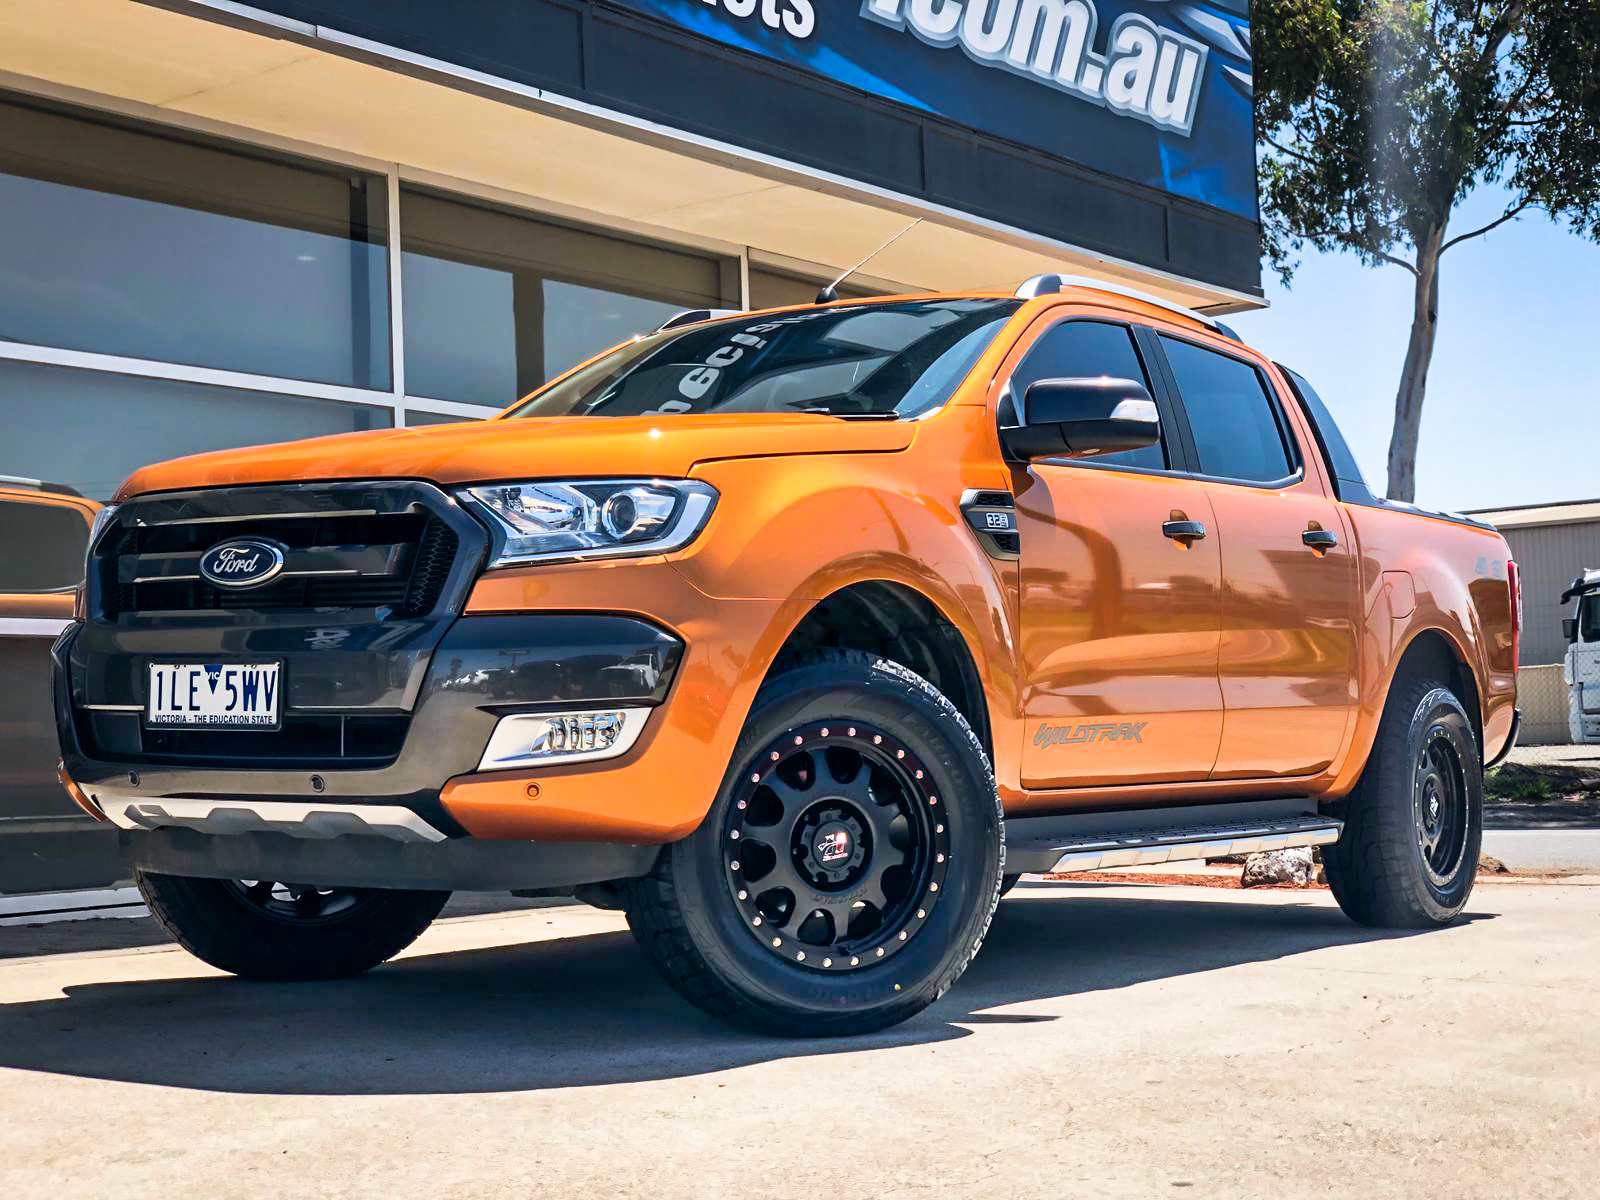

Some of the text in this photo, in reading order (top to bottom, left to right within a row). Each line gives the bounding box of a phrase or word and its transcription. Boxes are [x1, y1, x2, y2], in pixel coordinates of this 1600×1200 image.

[213, 547, 260, 574] Ford
[154, 714, 187, 723] VICTORIA
[193, 714, 207, 724] THE
[209, 715, 250, 724] EDUCATION
[251, 715, 273, 724] STATE
